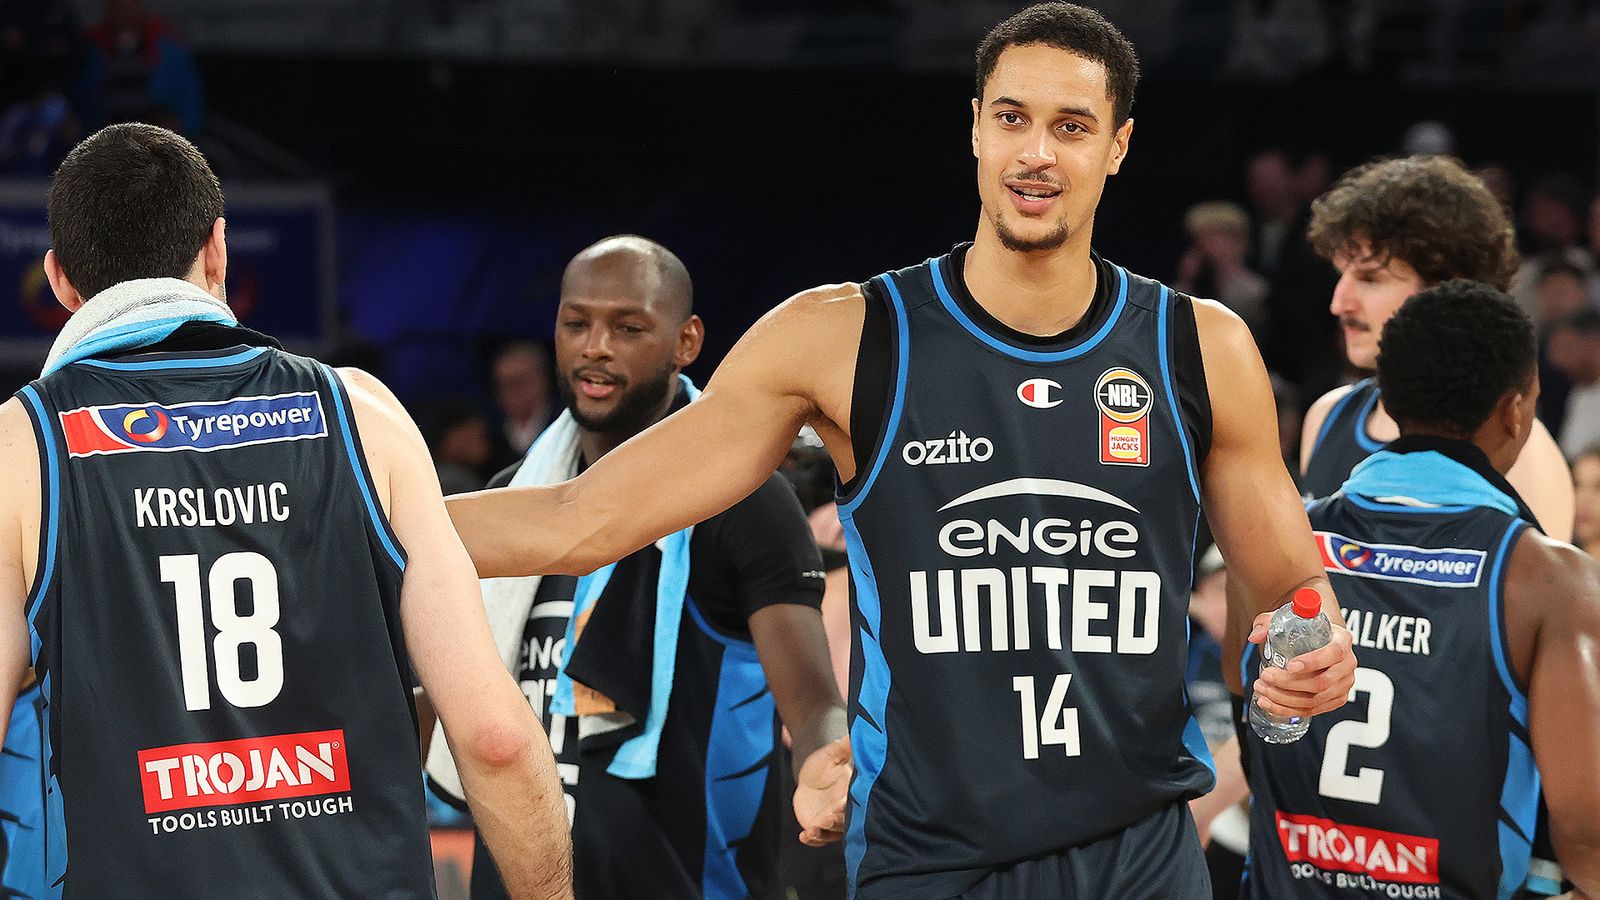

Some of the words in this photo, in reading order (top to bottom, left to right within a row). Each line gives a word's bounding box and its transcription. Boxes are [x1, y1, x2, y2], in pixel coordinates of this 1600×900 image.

[1107, 383, 1141, 408] NBL
[172, 405, 313, 442] Tyrepower
[1110, 435, 1139, 443] HUNGRY
[902, 429, 994, 466] ozito
[134, 481, 291, 528] KRSLOVIC
[1373, 552, 1477, 576] Tyrepower
[158, 551, 285, 712] 18
[909, 566, 1162, 655] UNITED
[1012, 673, 1082, 760] 14
[1318, 667, 1395, 805] 2
[145, 742, 336, 801] TROJAN
[148, 811, 218, 835] TOOLS
[220, 804, 274, 828] BUILT
[278, 795, 354, 820] TOUGH
